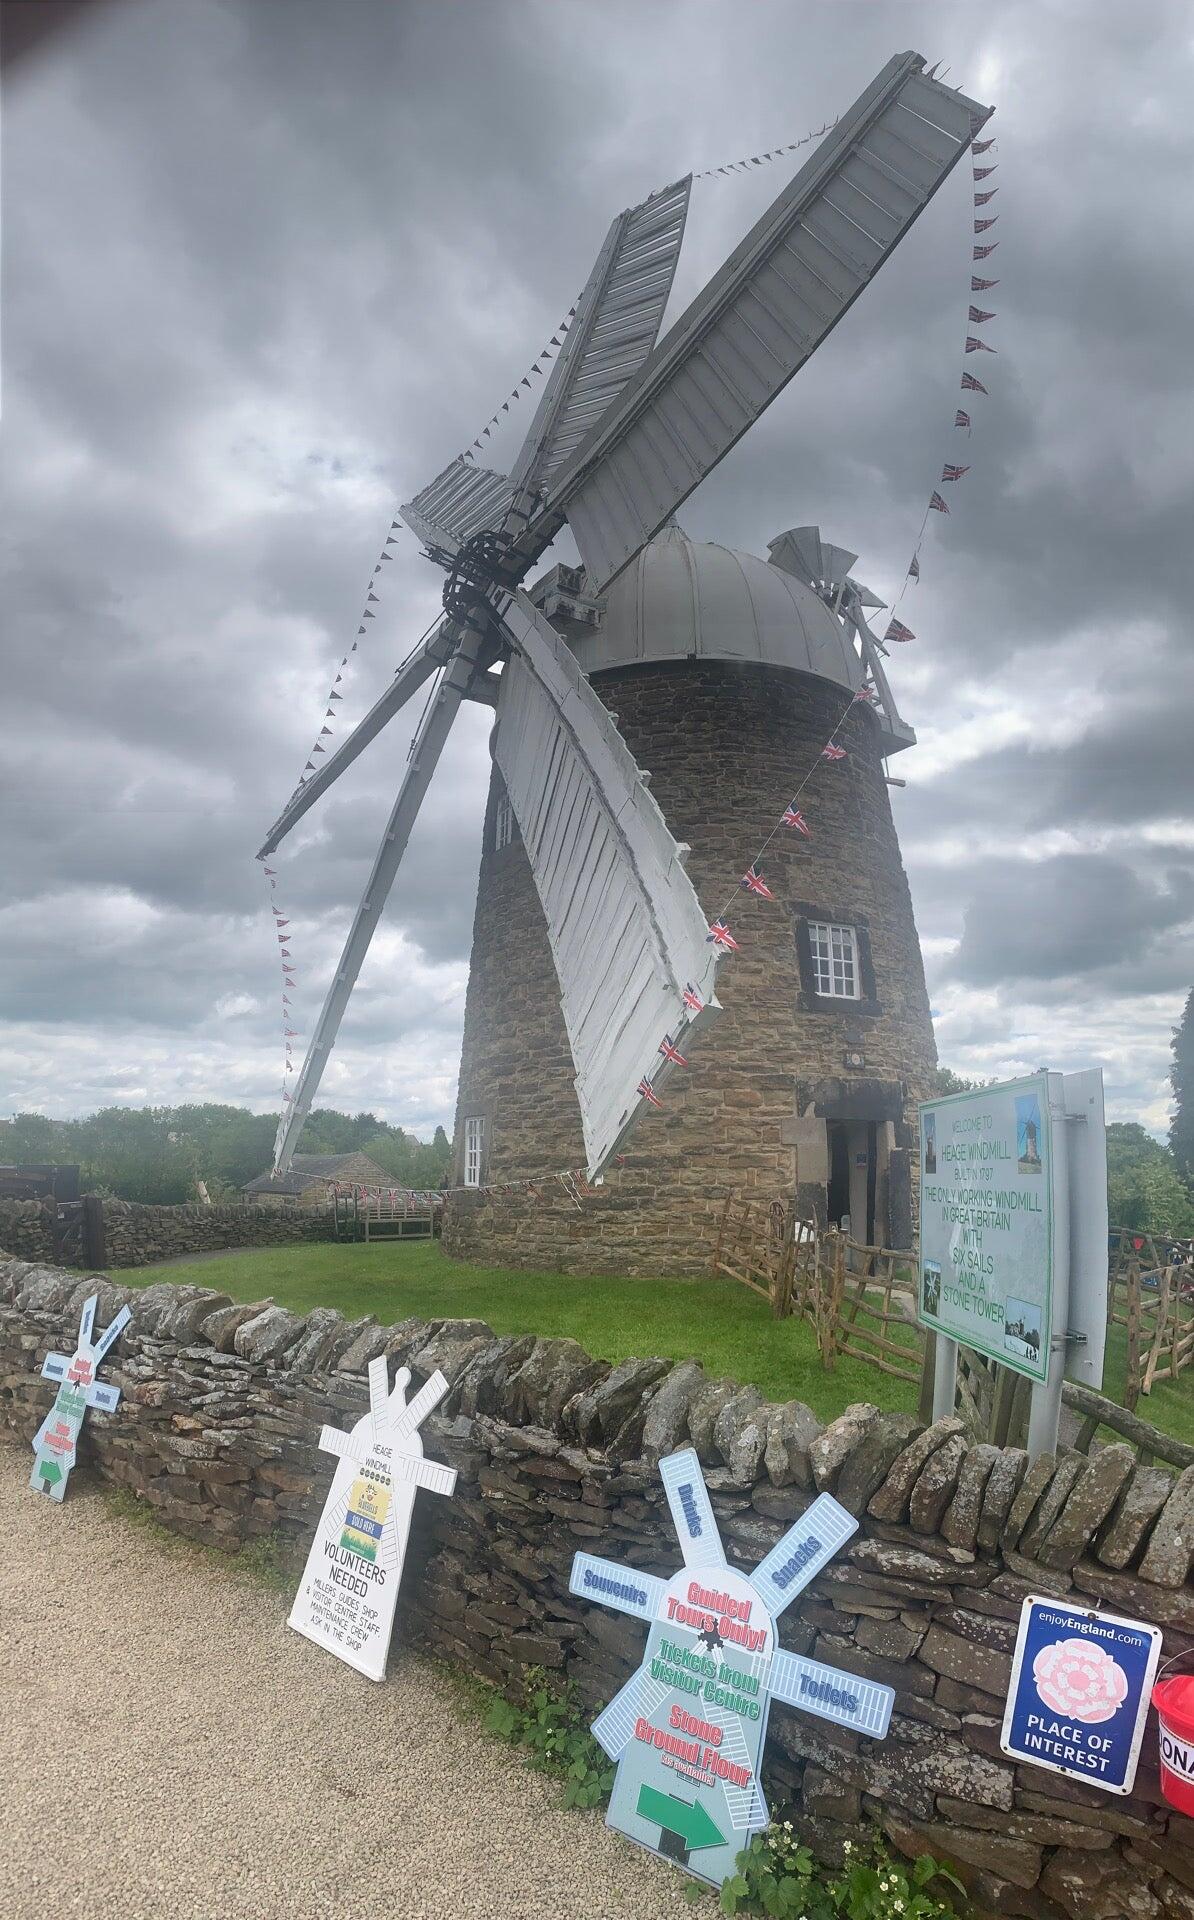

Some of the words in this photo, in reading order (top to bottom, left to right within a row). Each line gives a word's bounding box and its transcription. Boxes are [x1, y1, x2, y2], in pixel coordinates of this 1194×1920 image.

[952, 1117, 980, 1133] WELCOME
[982, 1115, 993, 1129] TO
[942, 1144, 966, 1161] HEAGE
[969, 1140, 1011, 1160] WINDMILL
[954, 1168, 970, 1180] BUILT
[979, 1168, 993, 1181] 1797
[925, 1186, 936, 1202] THE
[937, 1187, 956, 1203] ONLY
[958, 1189, 992, 1207] WORKING
[995, 1191, 1042, 1212] WINDMILL
[943, 1207, 950, 1220] IN
[950, 1207, 975, 1224] GREAT
[977, 1210, 1010, 1230] BRITAIN
[963, 1228, 983, 1248] WITH
[952, 1247, 966, 1266] SIX
[967, 1251, 993, 1275] SAILS
[959, 1270, 976, 1290] AND
[979, 1276, 986, 1295] A
[943, 1285, 970, 1311] STONE
[972, 1296, 1005, 1325] TOWER
[365, 1457, 392, 1475] WINDMILL
[372, 1443, 393, 1459] HEAGE
[678, 1483, 703, 1538] Drinks
[324, 1540, 386, 1585] VOLUNTEERS
[771, 1535, 822, 1590] Snacks
[329, 1564, 368, 1598] NEEDED
[584, 1569, 648, 1606] Souvenirs
[312, 1589, 332, 1607] VISITOR
[334, 1602, 358, 1623] CENTRE
[362, 1605, 379, 1620] SHOP
[687, 1582, 752, 1622] Guided
[310, 1601, 349, 1631] MAINTENANCE
[351, 1625, 369, 1642] CREW
[333, 1627, 344, 1642] THE
[346, 1636, 362, 1652] SHOP
[667, 1597, 715, 1632] Tours
[718, 1616, 767, 1653] Only!
[1039, 1611, 1142, 1647] enjoyEngland.com
[660, 1638, 717, 1678] Tickets
[719, 1662, 759, 1696] from
[650, 1658, 702, 1696] Visitor
[703, 1680, 760, 1720] Centre
[800, 1673, 858, 1713] Toilets
[669, 1704, 723, 1747] Stone
[1027, 1714, 1082, 1744] PLACE
[1088, 1734, 1113, 1753] OF
[634, 1717, 701, 1765] Ground
[701, 1747, 752, 1788] Flour
[1024, 1732, 1110, 1773] INTEREST
